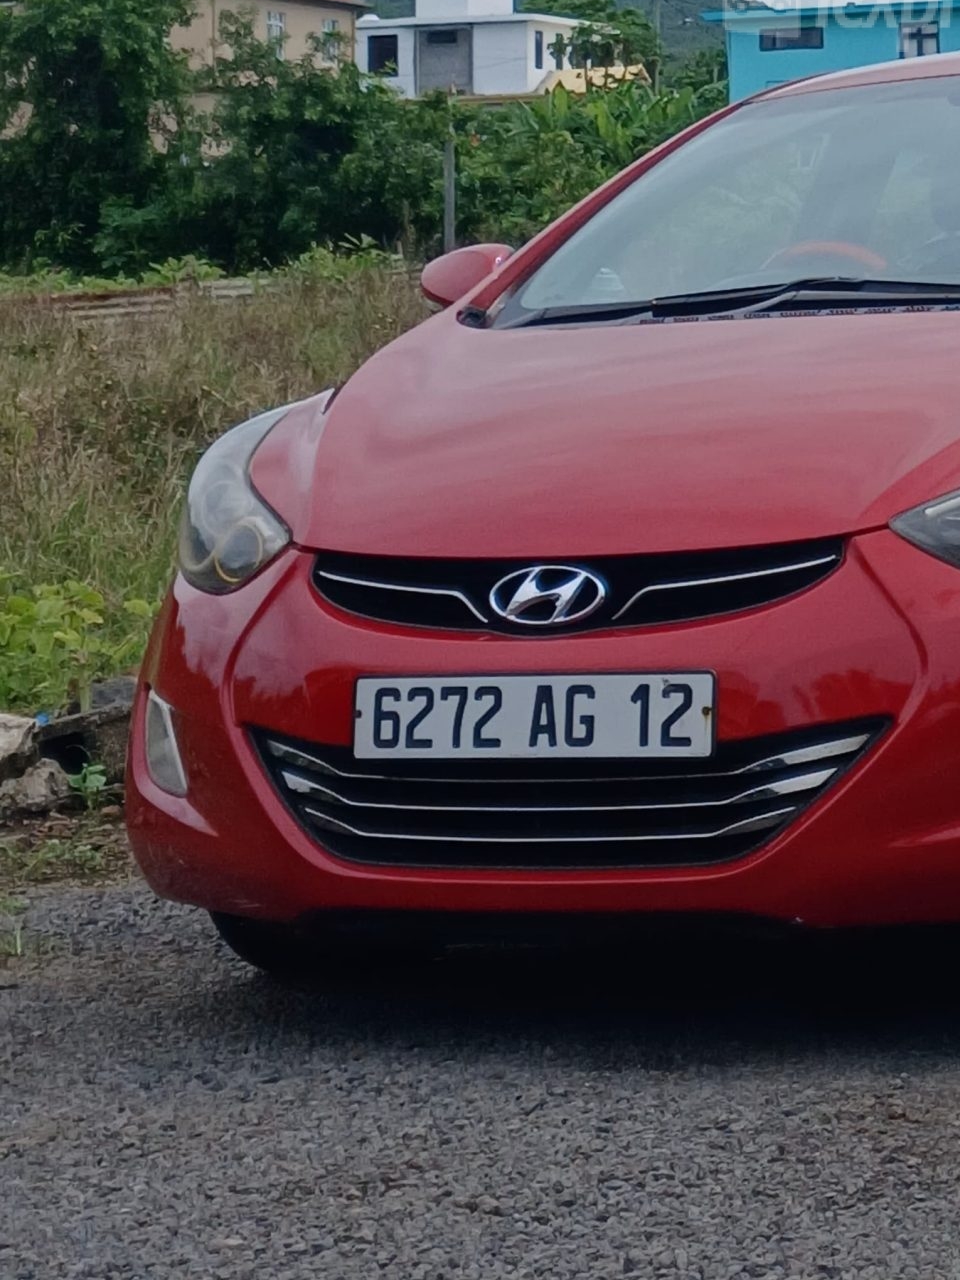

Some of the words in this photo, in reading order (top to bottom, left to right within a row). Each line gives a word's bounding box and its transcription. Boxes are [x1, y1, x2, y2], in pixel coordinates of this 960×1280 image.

[373, 686, 502, 749] 6272
[528, 684, 596, 747] AG
[630, 683, 693, 747] 12
